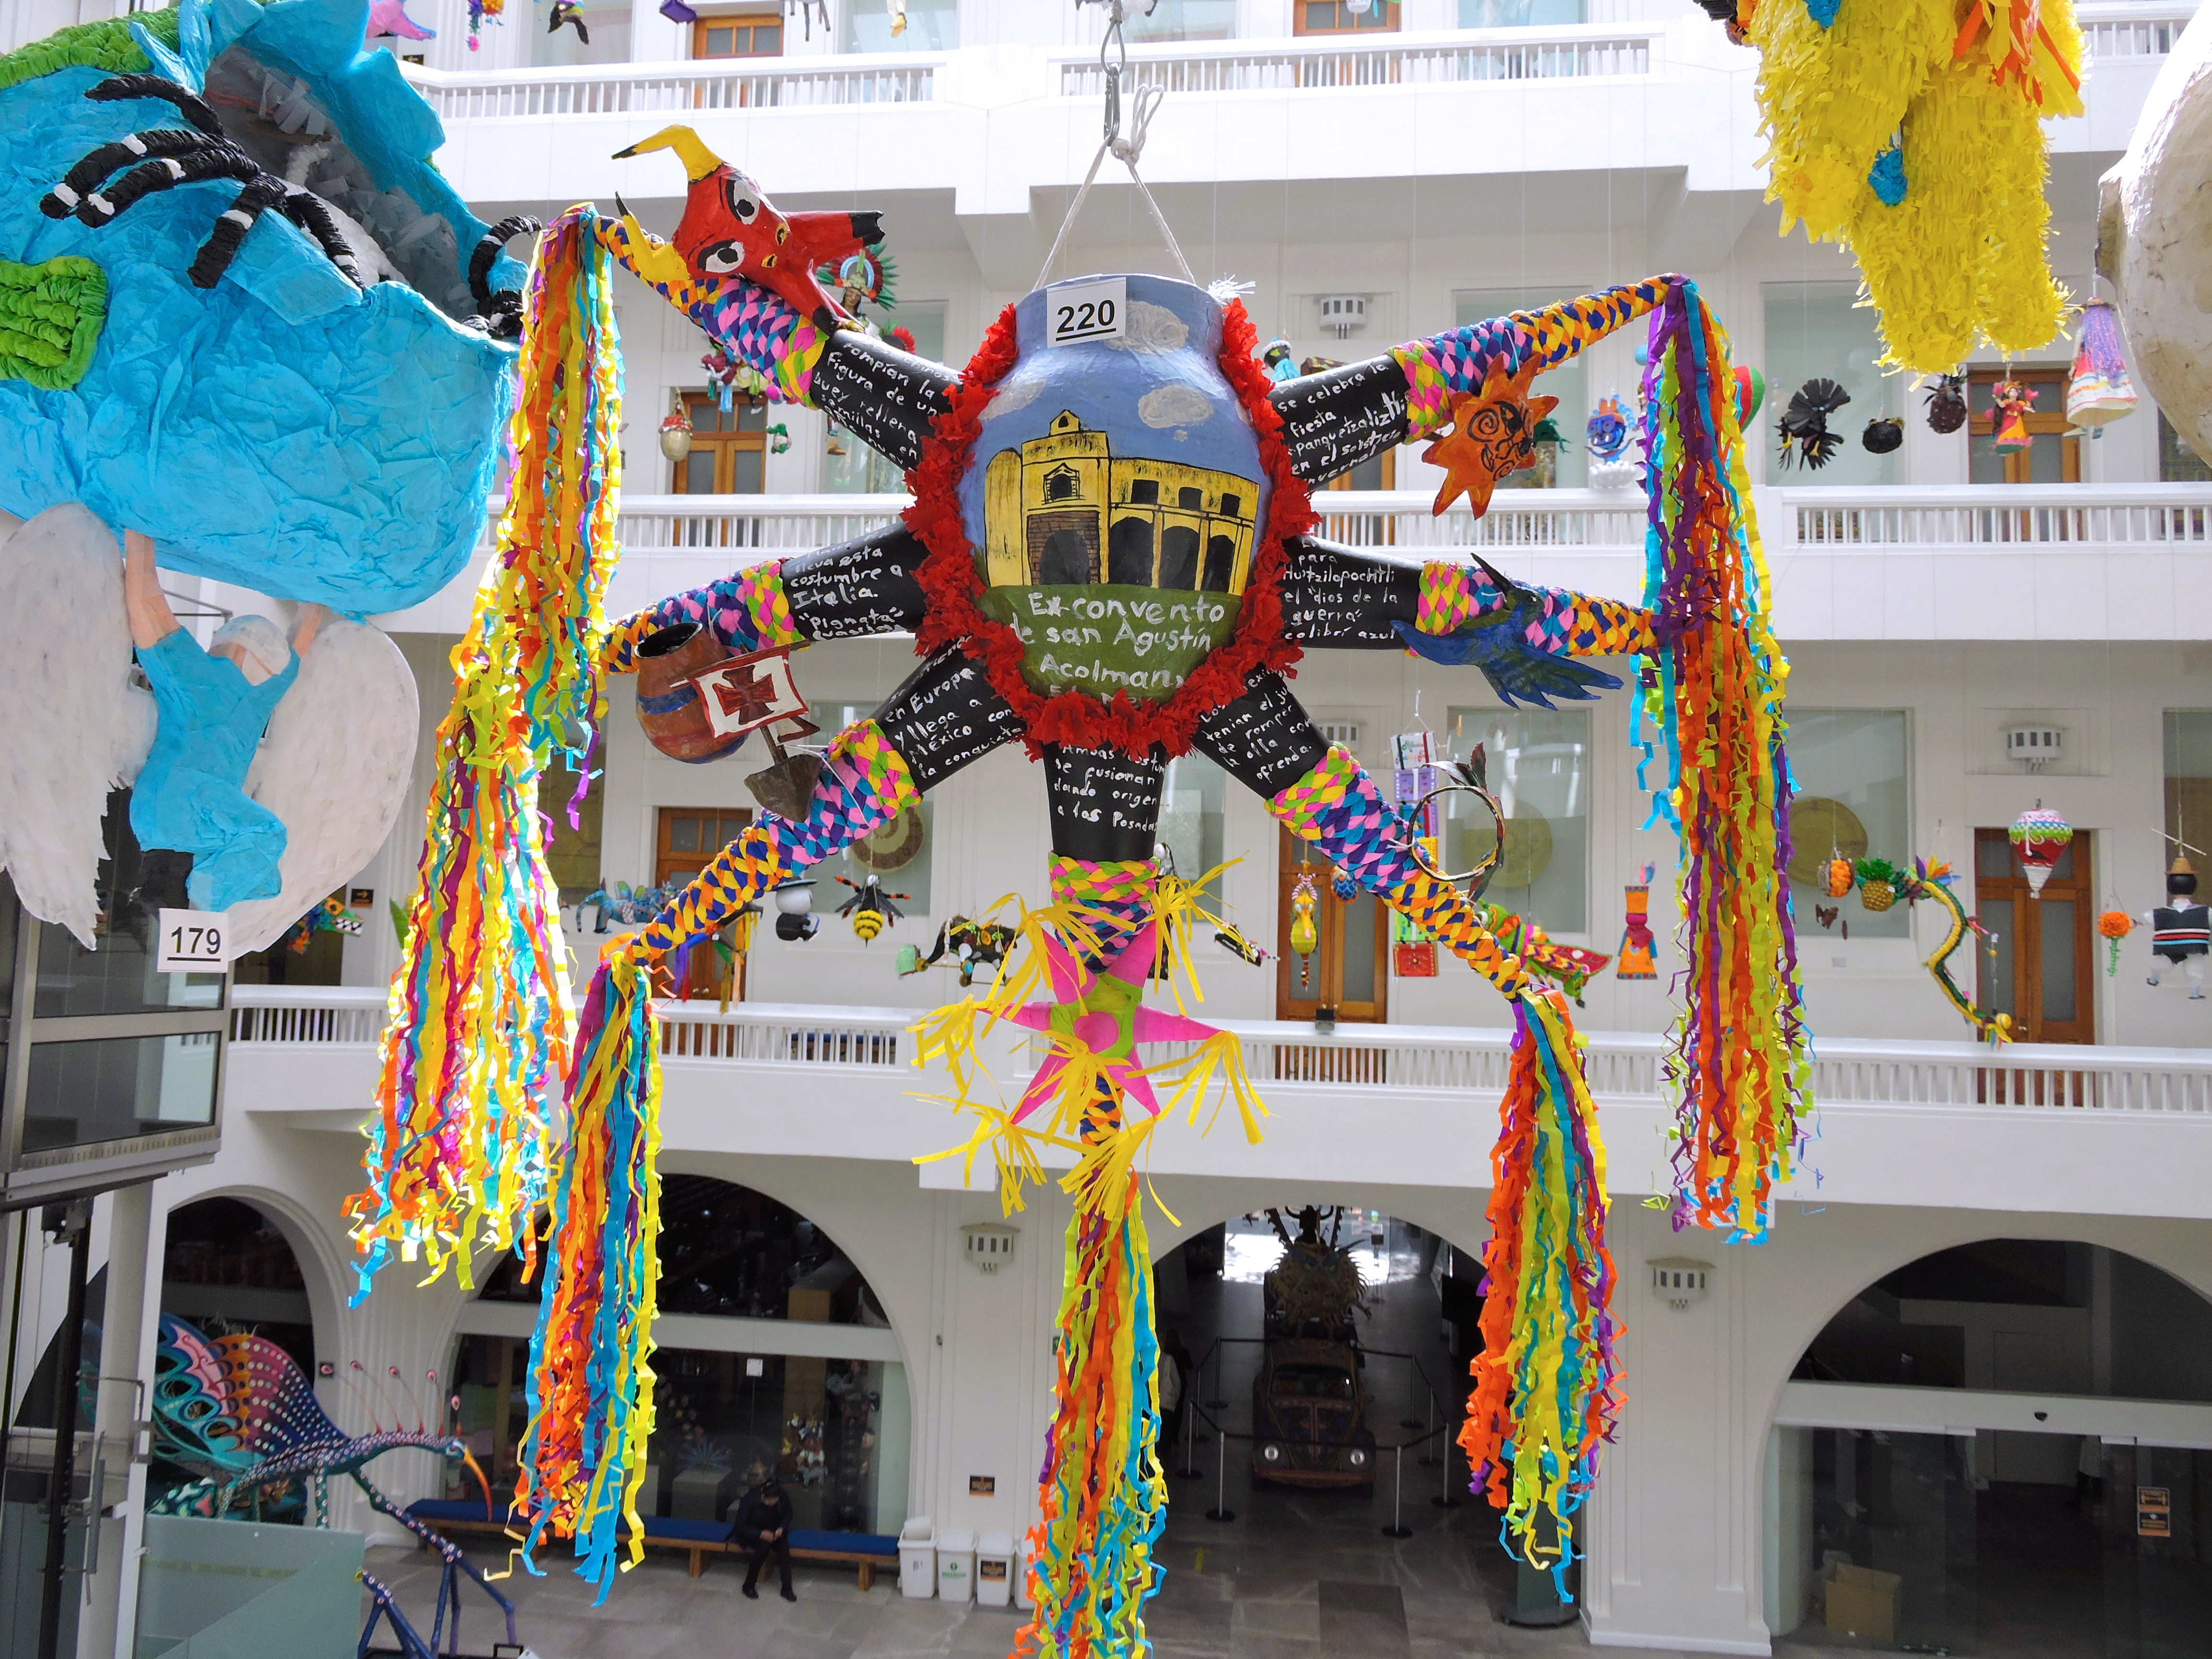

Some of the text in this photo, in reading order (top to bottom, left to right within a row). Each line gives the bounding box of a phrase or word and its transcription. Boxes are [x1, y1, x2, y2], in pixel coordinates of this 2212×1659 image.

[1057, 299, 1115, 333] 220
[886, 387, 904, 406] de
[917, 401, 937, 416] un
[918, 380, 935, 400] la
[1278, 399, 1297, 412] se
[1308, 373, 1366, 404] celebra
[1369, 364, 1389, 375] la
[813, 372, 851, 403] buey
[860, 401, 917, 444] rellena
[1292, 461, 1311, 475] en
[1321, 443, 1337, 467] el
[839, 545, 883, 567] esta
[1298, 554, 1338, 566] para
[791, 565, 903, 587] costumbre a
[1284, 587, 1300, 605] el
[1353, 587, 1371, 603] de
[1383, 587, 1398, 604] la
[1046, 627, 1101, 646] san
[1112, 617, 1210, 657] Agustín
[1285, 622, 1395, 640] colibrí azul
[1039, 652, 1185, 689] Acolman,
[884, 667, 976, 723] en Europa
[894, 699, 983, 752] y llega a
[1200, 703, 1226, 723] Lo
[1245, 705, 1292, 740] romper
[909, 725, 972, 765] México
[1247, 738, 1278, 759] olla
[1055, 758, 1155, 786] se fusionan
[1054, 777, 1157, 809] dando origen
[1058, 800, 1158, 833] a las Posadas
[171, 926, 221, 955] 179
